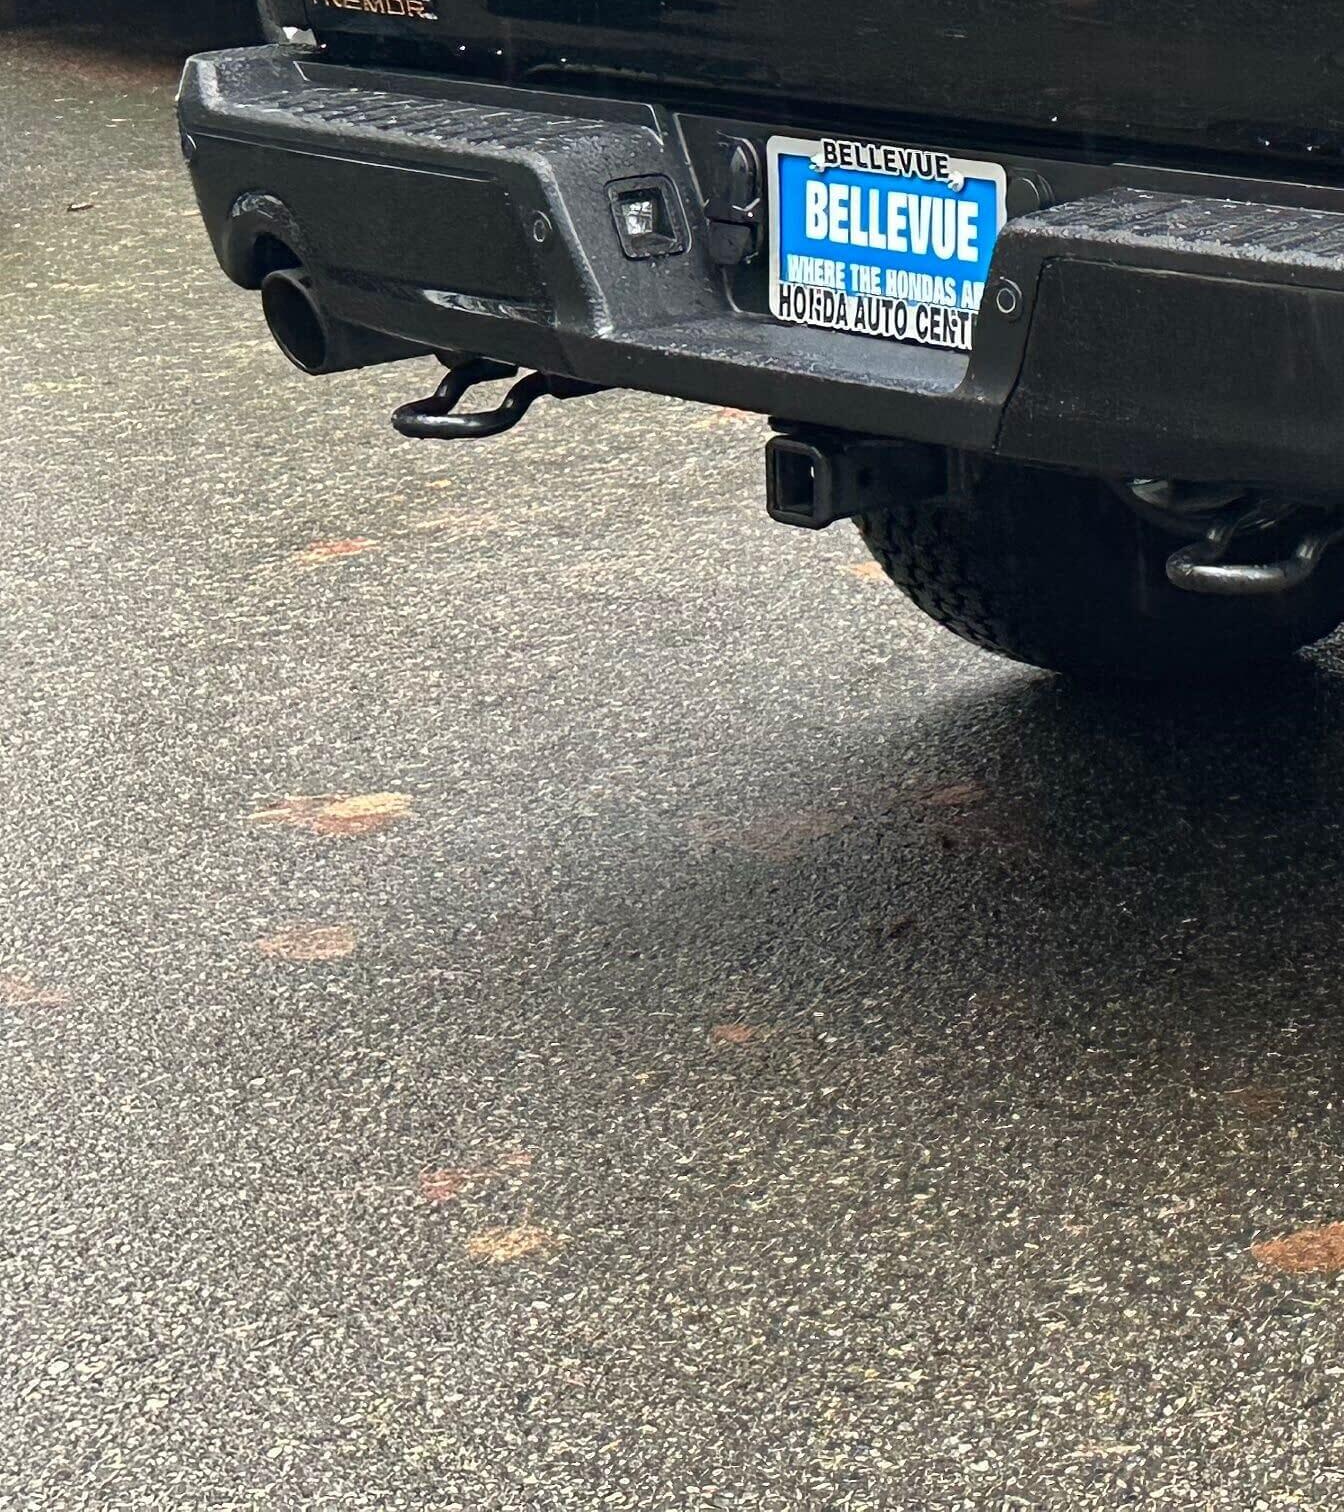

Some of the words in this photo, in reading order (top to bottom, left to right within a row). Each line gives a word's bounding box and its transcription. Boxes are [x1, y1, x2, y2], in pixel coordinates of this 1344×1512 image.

[823, 142, 949, 178] BELLEVUE
[805, 180, 979, 262] BELLEVUE
[787, 254, 846, 290] WHERE
[850, 263, 881, 295] THE
[885, 269, 956, 308] HONDAS
[779, 284, 848, 326] HONDA
[855, 294, 907, 337] AUTO
[916, 304, 977, 345] CENT
